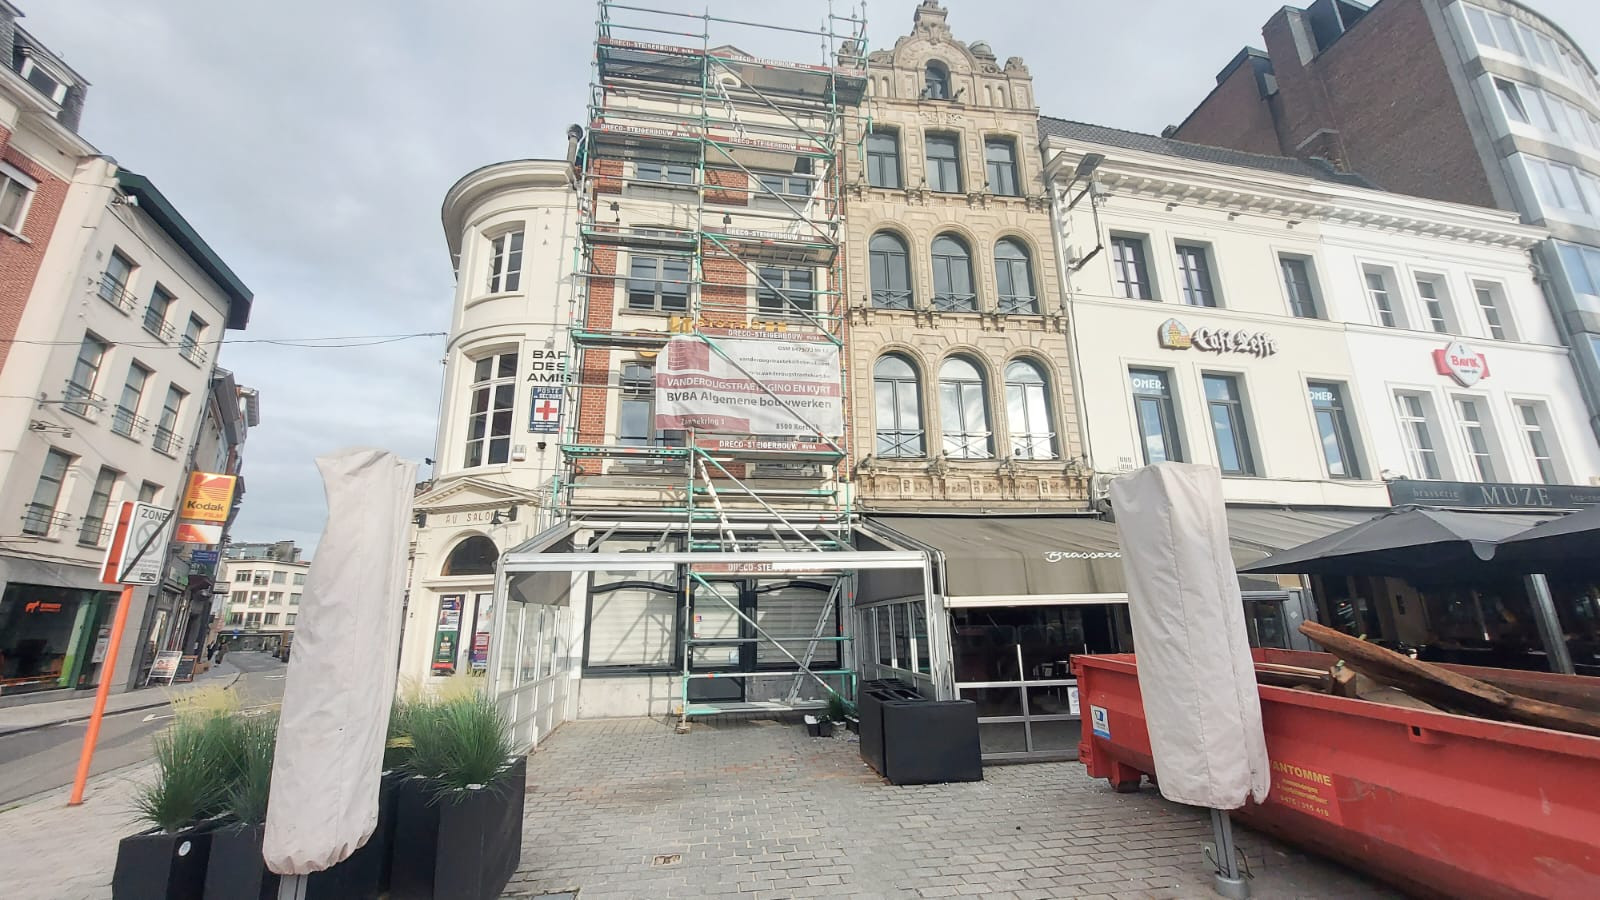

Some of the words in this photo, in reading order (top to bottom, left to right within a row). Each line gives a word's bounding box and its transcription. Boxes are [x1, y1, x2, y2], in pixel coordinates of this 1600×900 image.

[609, 39, 678, 53] DRECO-STEIGERBOUW
[601, 124, 673, 136] DRECO-STEIGERBOUW
[729, 138, 796, 150] DRECO-STEIGERBOUW
[727, 228, 798, 240] DRECO-STEIGERBOUW
[728, 329, 802, 341] DRECO-STEIGERBOUW
[527, 373, 572, 382] AMIS
[768, 384, 792, 393] GINO
[793, 384, 806, 393] EN
[807, 385, 832, 395] KURT
[667, 391, 697, 402] BVBA
[701, 391, 757, 406] Algemene
[719, 441, 797, 450] DRECO-STEIGERBOUW
[1480, 485, 1553, 506] MUZE
[187, 500, 224, 512] Kodak
[141, 508, 168, 520] ZONE
[1270, 761, 1332, 787] ANTOMME
